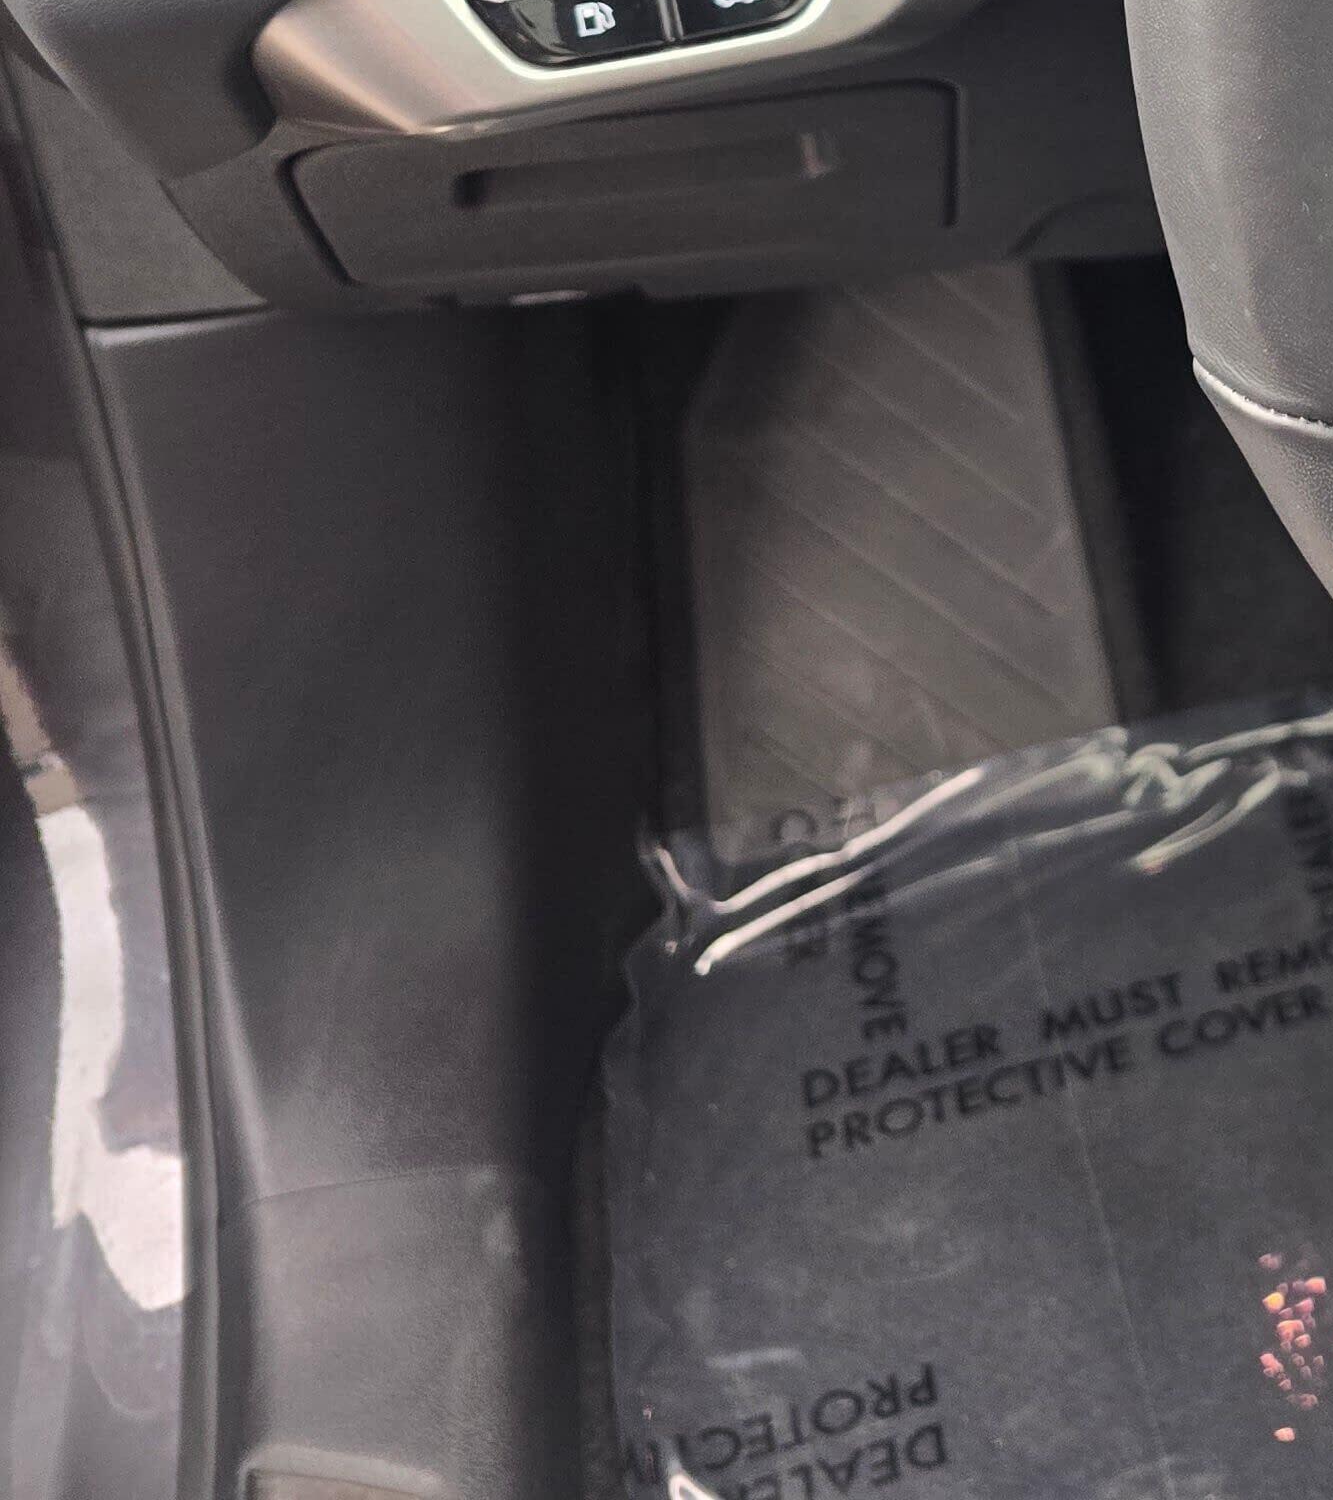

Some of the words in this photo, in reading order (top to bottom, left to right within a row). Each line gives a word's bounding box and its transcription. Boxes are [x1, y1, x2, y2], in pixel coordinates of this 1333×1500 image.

[801, 1023, 1003, 1109] DEALER
[1040, 971, 1186, 1043] MUST
[803, 1033, 1133, 1161] PROTECTIVE
[1156, 982, 1330, 1060] COVER
